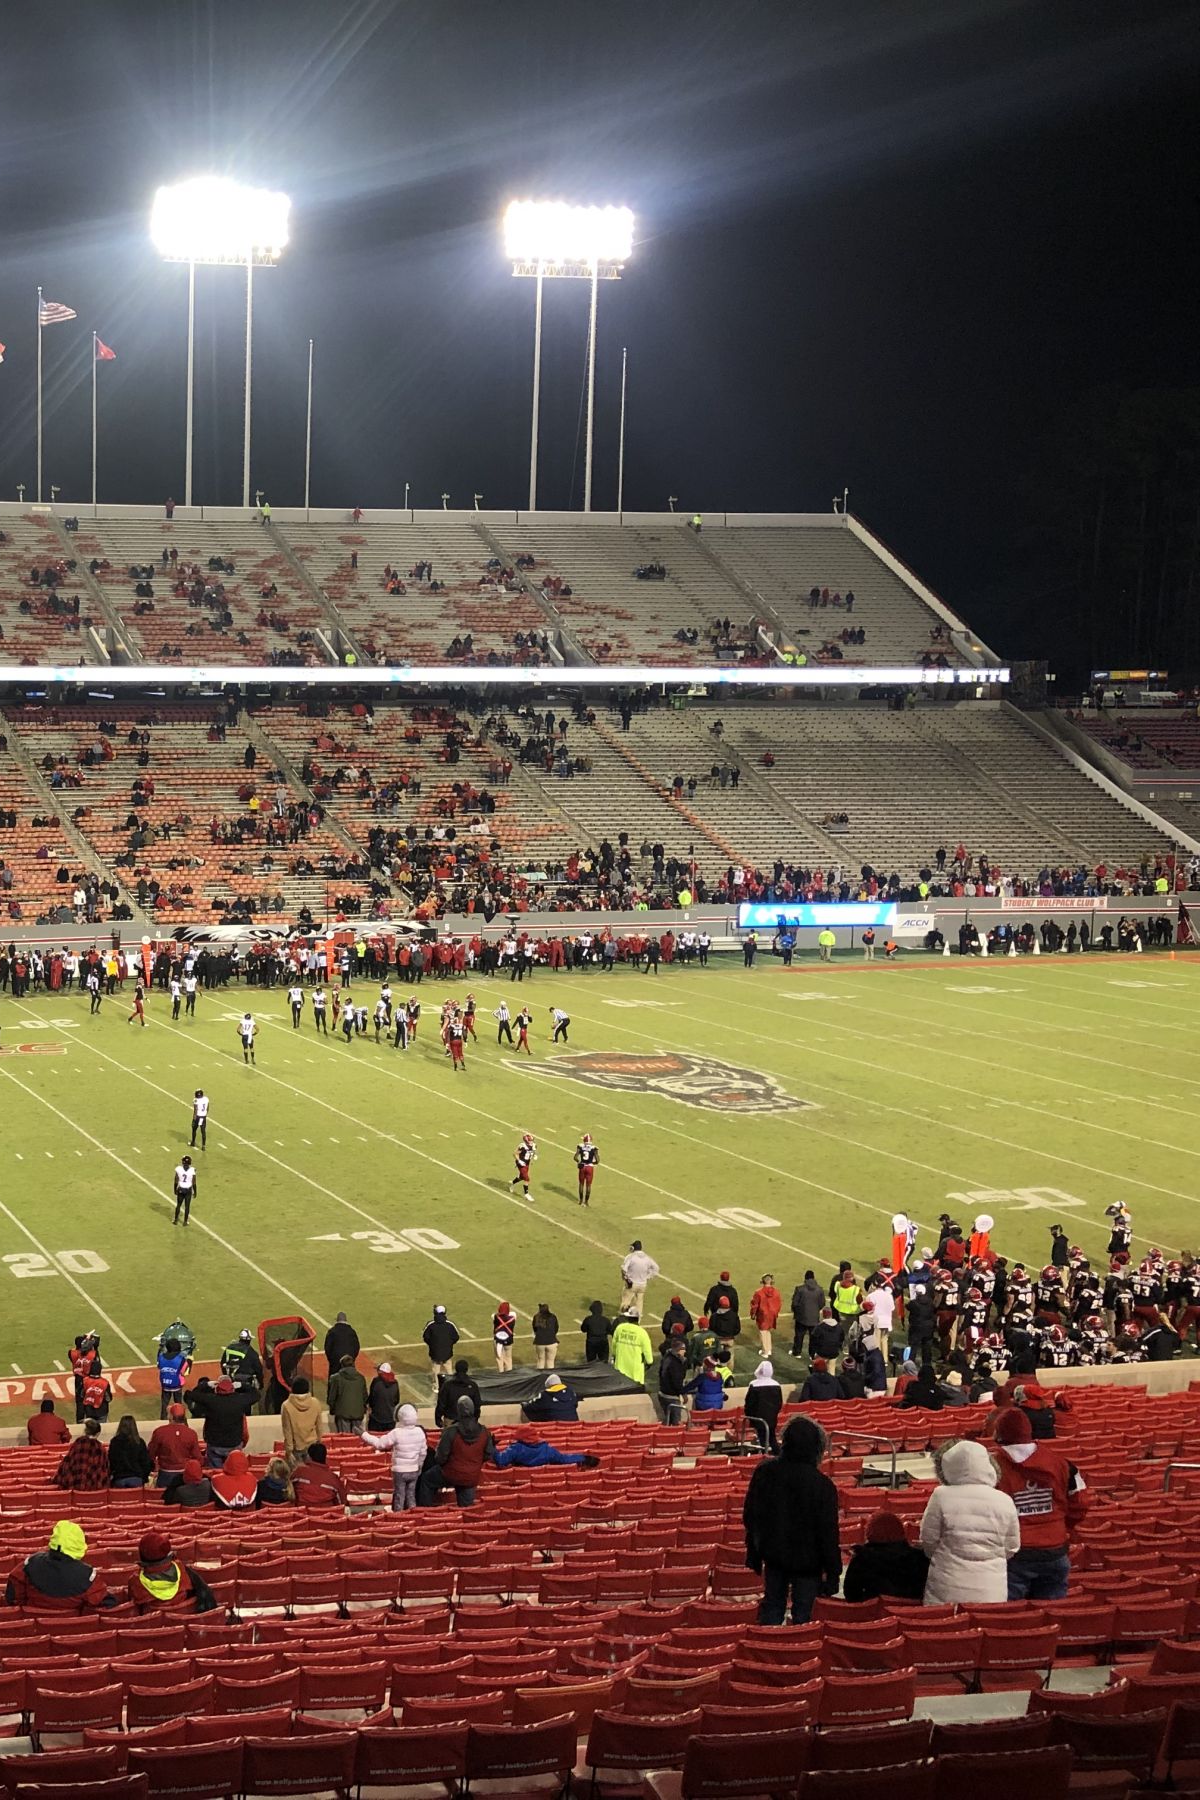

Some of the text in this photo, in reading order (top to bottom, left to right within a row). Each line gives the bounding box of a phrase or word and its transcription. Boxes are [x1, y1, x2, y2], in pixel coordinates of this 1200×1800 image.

[1003, 898, 1095, 907] STUDENT WOLFPACK CLUB
[902, 919, 929, 927] ACCN
[669, 1207, 781, 1230] 40
[351, 1227, 460, 1253] 30
[1, 1249, 111, 1278] 20
[1133, 1284, 1151, 1297] 93
[989, 1359, 1007, 1371] 27
[1052, 1353, 1067, 1366] 12
[1018, 1504, 1051, 1514] Admiral
